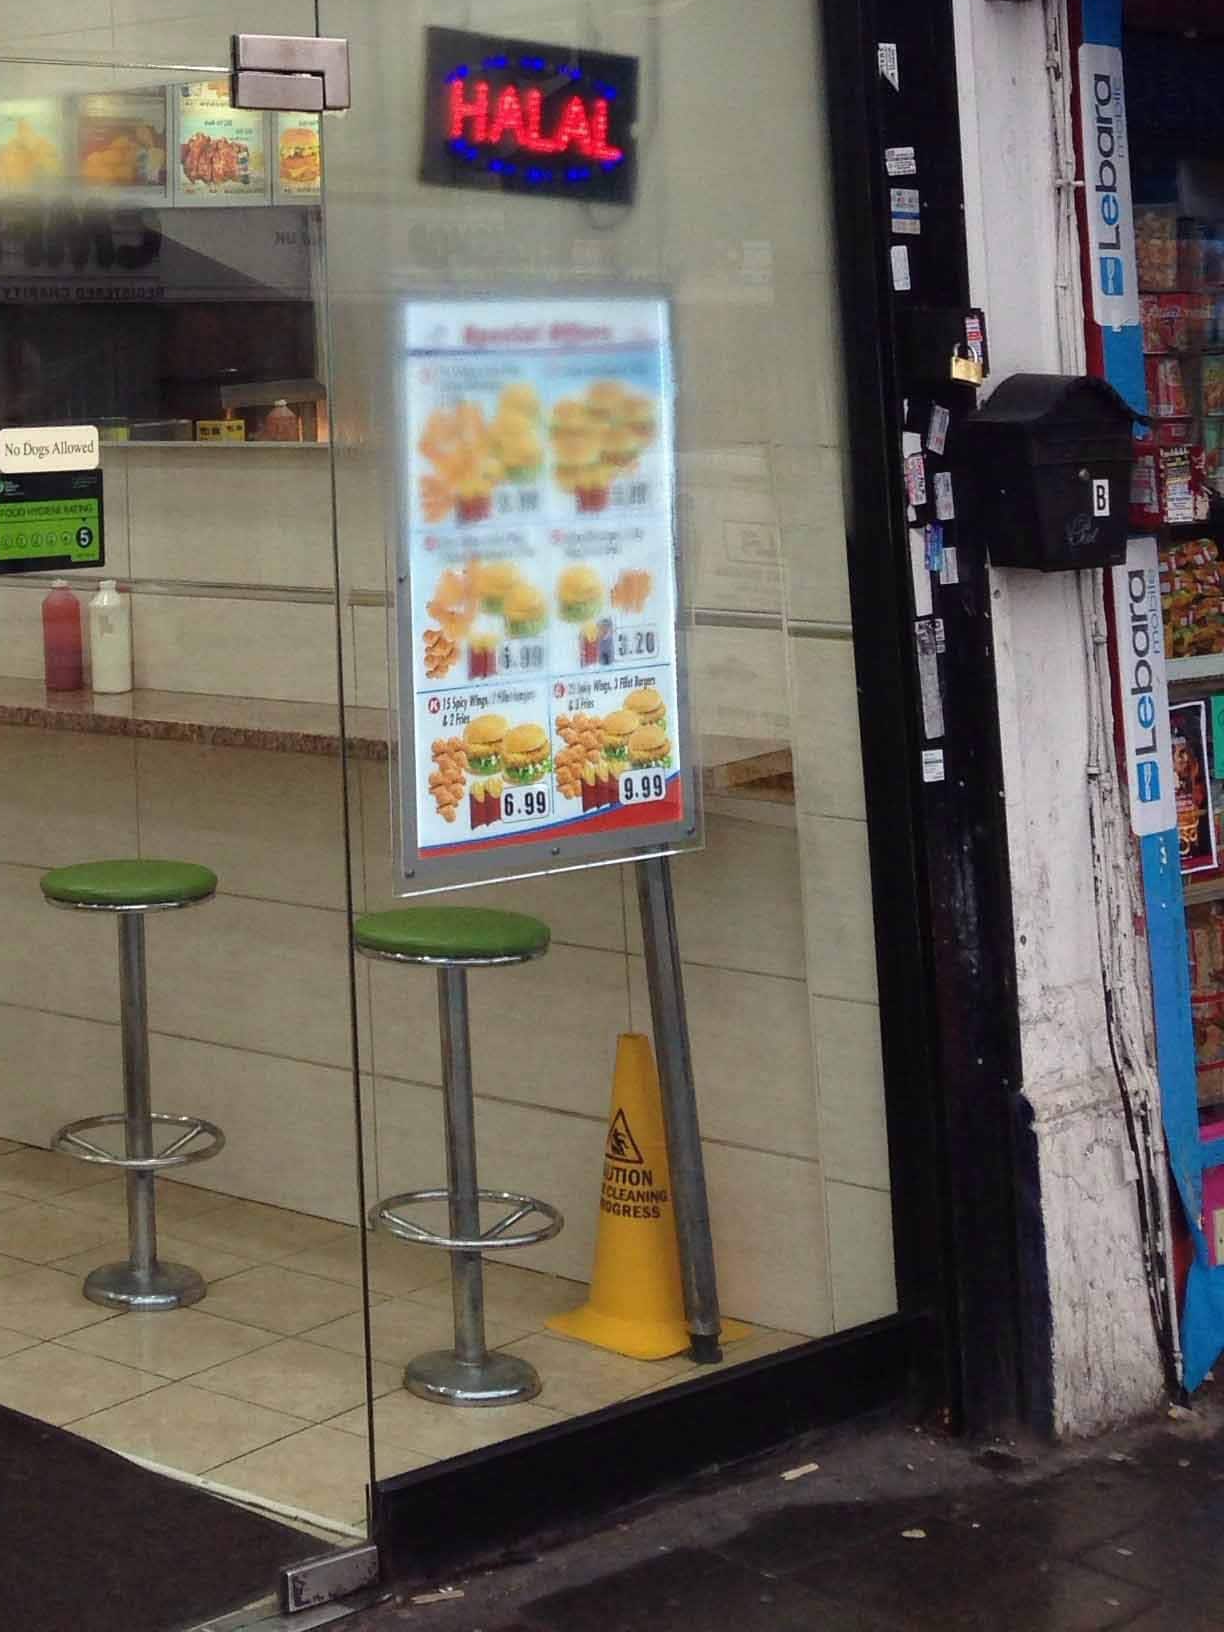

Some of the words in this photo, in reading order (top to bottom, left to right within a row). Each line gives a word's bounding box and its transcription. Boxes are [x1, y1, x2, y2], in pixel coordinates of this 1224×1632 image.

[448, 80, 623, 161] HALAL
[1094, 74, 1121, 250] Lebara
[4, 442, 20, 457] No
[23, 441, 50, 459] Dogs
[52, 440, 95, 454] Allowed
[1095, 484, 1107, 510] B
[79, 529, 90, 546] 5
[1128, 569, 1157, 755] Lebara
[624, 774, 663, 801] 9.99
[504, 791, 546, 816] 6.99
